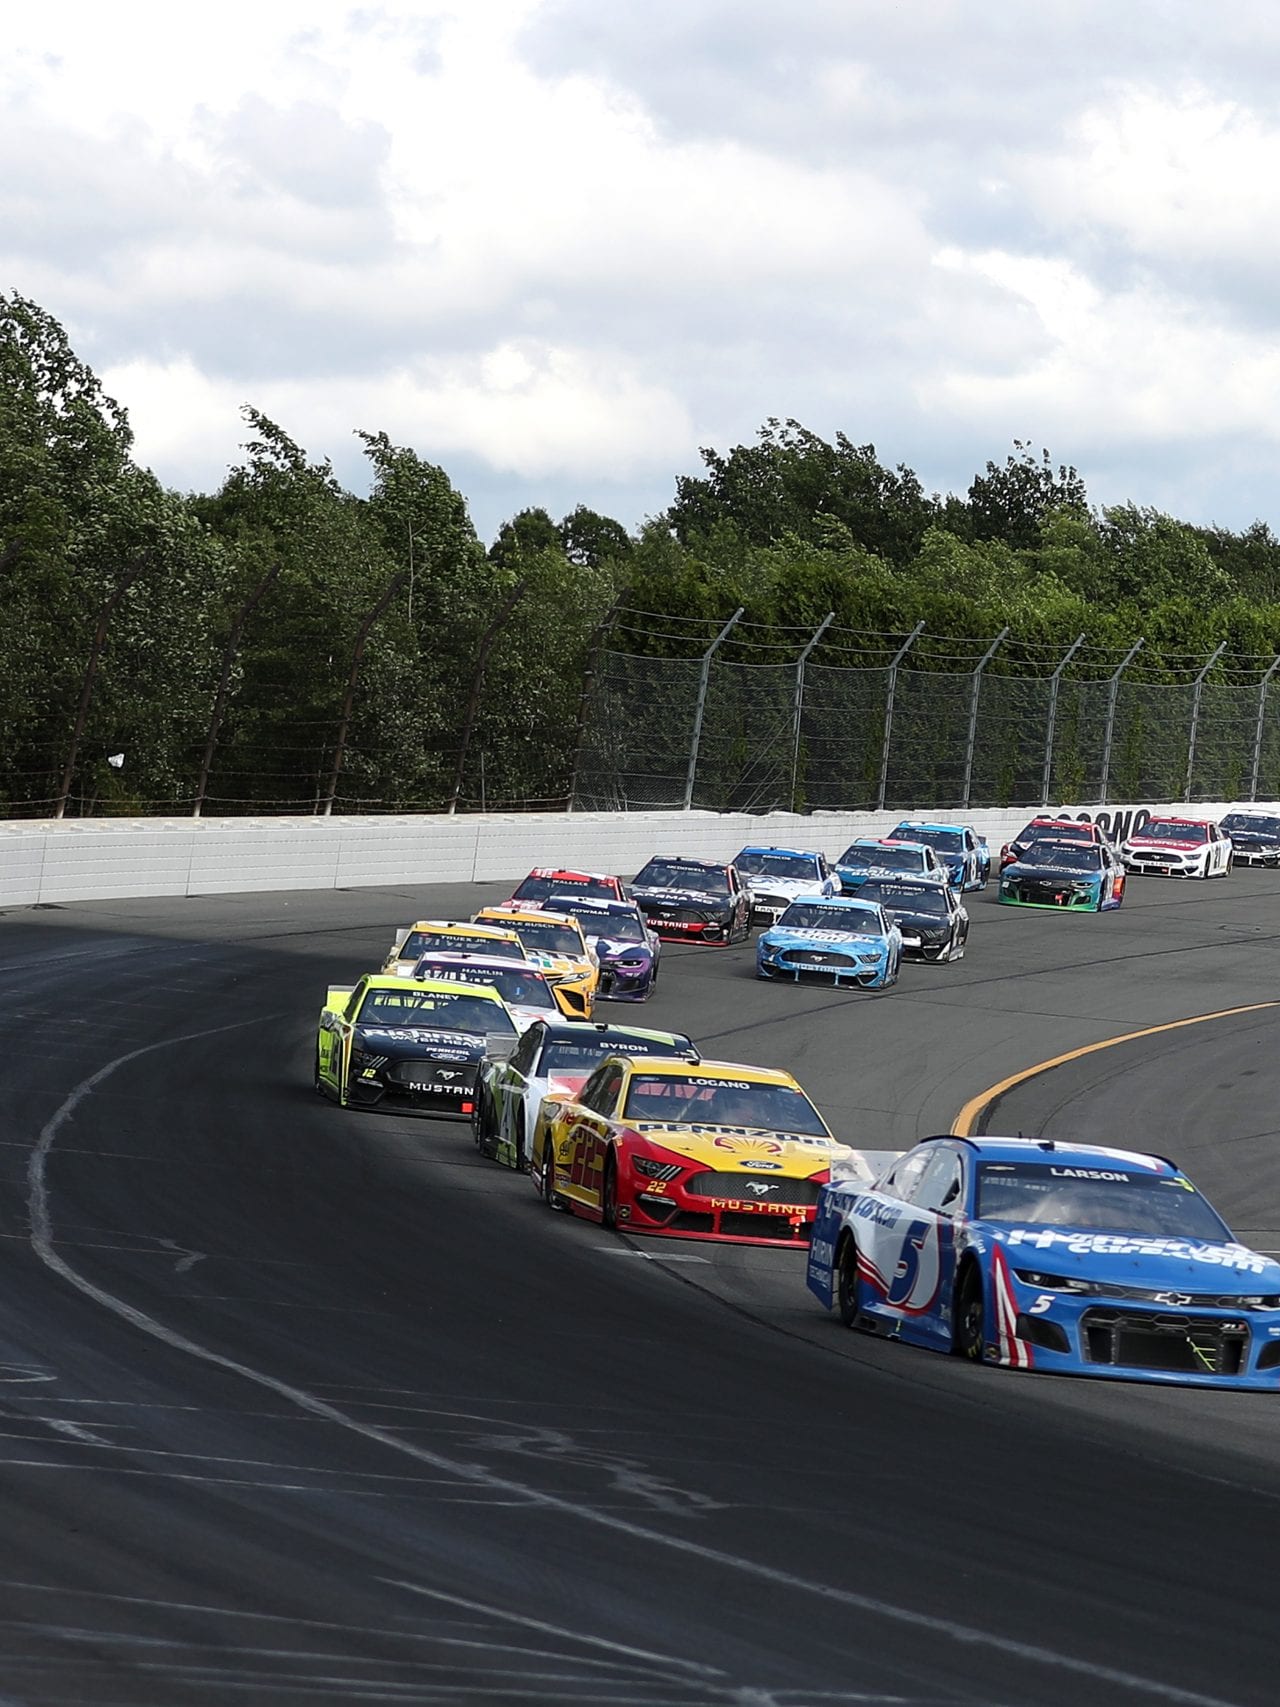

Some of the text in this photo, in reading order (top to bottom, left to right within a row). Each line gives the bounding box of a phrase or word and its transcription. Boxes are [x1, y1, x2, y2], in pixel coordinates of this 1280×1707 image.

[969, 853, 978, 882] 8
[552, 879, 588, 887] WALLACE
[569, 907, 610, 916] BOWMAN
[816, 905, 852, 913] HARVICK
[441, 935, 473, 943] TRUEX
[461, 968, 504, 976] HAMLIN
[412, 991, 460, 1001] BLANEY
[425, 1047, 470, 1056] PENNZOIL
[599, 1042, 649, 1052] BYRON
[361, 1068, 377, 1078] 12
[408, 1081, 475, 1096] MUSTAN
[688, 1077, 751, 1090] LOGANO
[1050, 1167, 1129, 1183] LARSON
[646, 1180, 667, 1193] 22
[711, 1198, 808, 1216] MUSTANG
[886, 1219, 935, 1306] 5
[1028, 1294, 1057, 1314] 5
